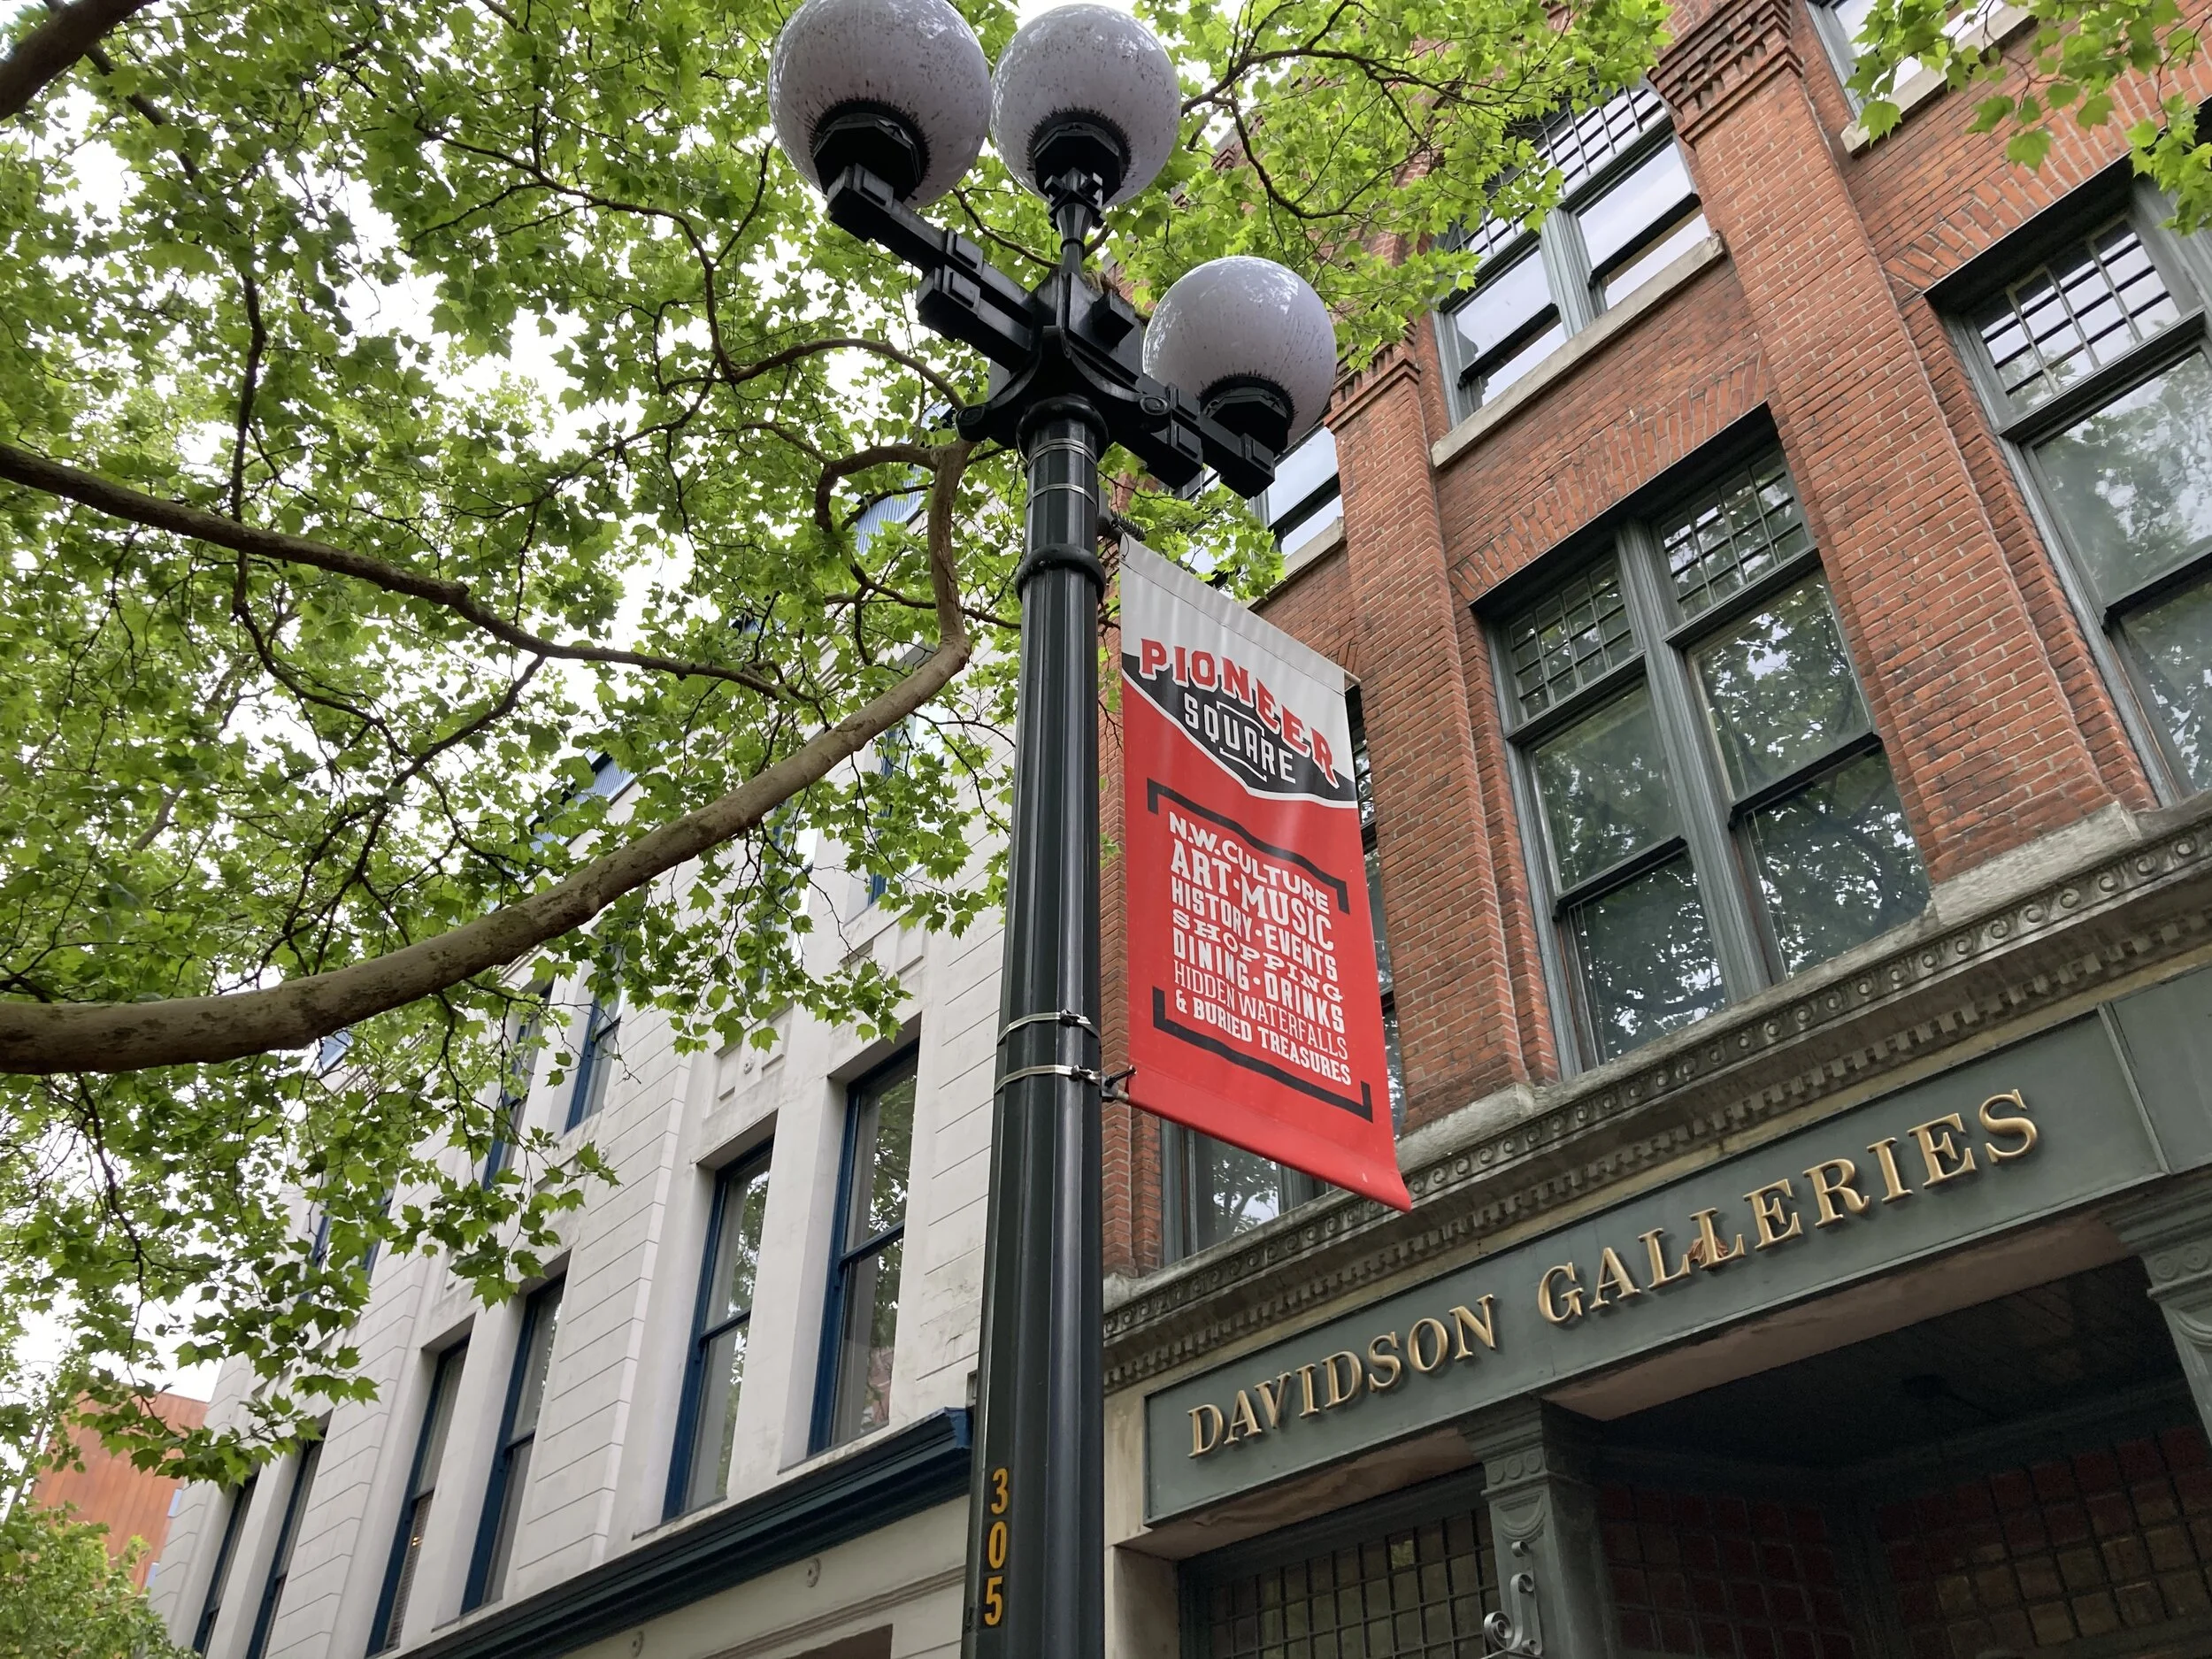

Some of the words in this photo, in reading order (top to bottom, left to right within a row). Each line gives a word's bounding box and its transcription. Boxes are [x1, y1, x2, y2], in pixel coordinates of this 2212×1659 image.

[1141, 638, 1340, 788] PIONEER
[1184, 693, 1296, 784] SQUARE
[1222, 840, 1330, 915] CULTURE
[1172, 909, 1343, 1002] SHOPPING
[1173, 959, 1235, 1011] HIDDEN
[1238, 991, 1348, 1060] WATERFALLS
[1175, 988, 1187, 1014] &
[1193, 996, 1253, 1042] BURIED
[1257, 1025, 1351, 1086] TREASURES
[1187, 1294, 1496, 1459] DAVIDSON
[1537, 1088, 2039, 1325] GALLERIES
[984, 1468, 1009, 1626] 305
